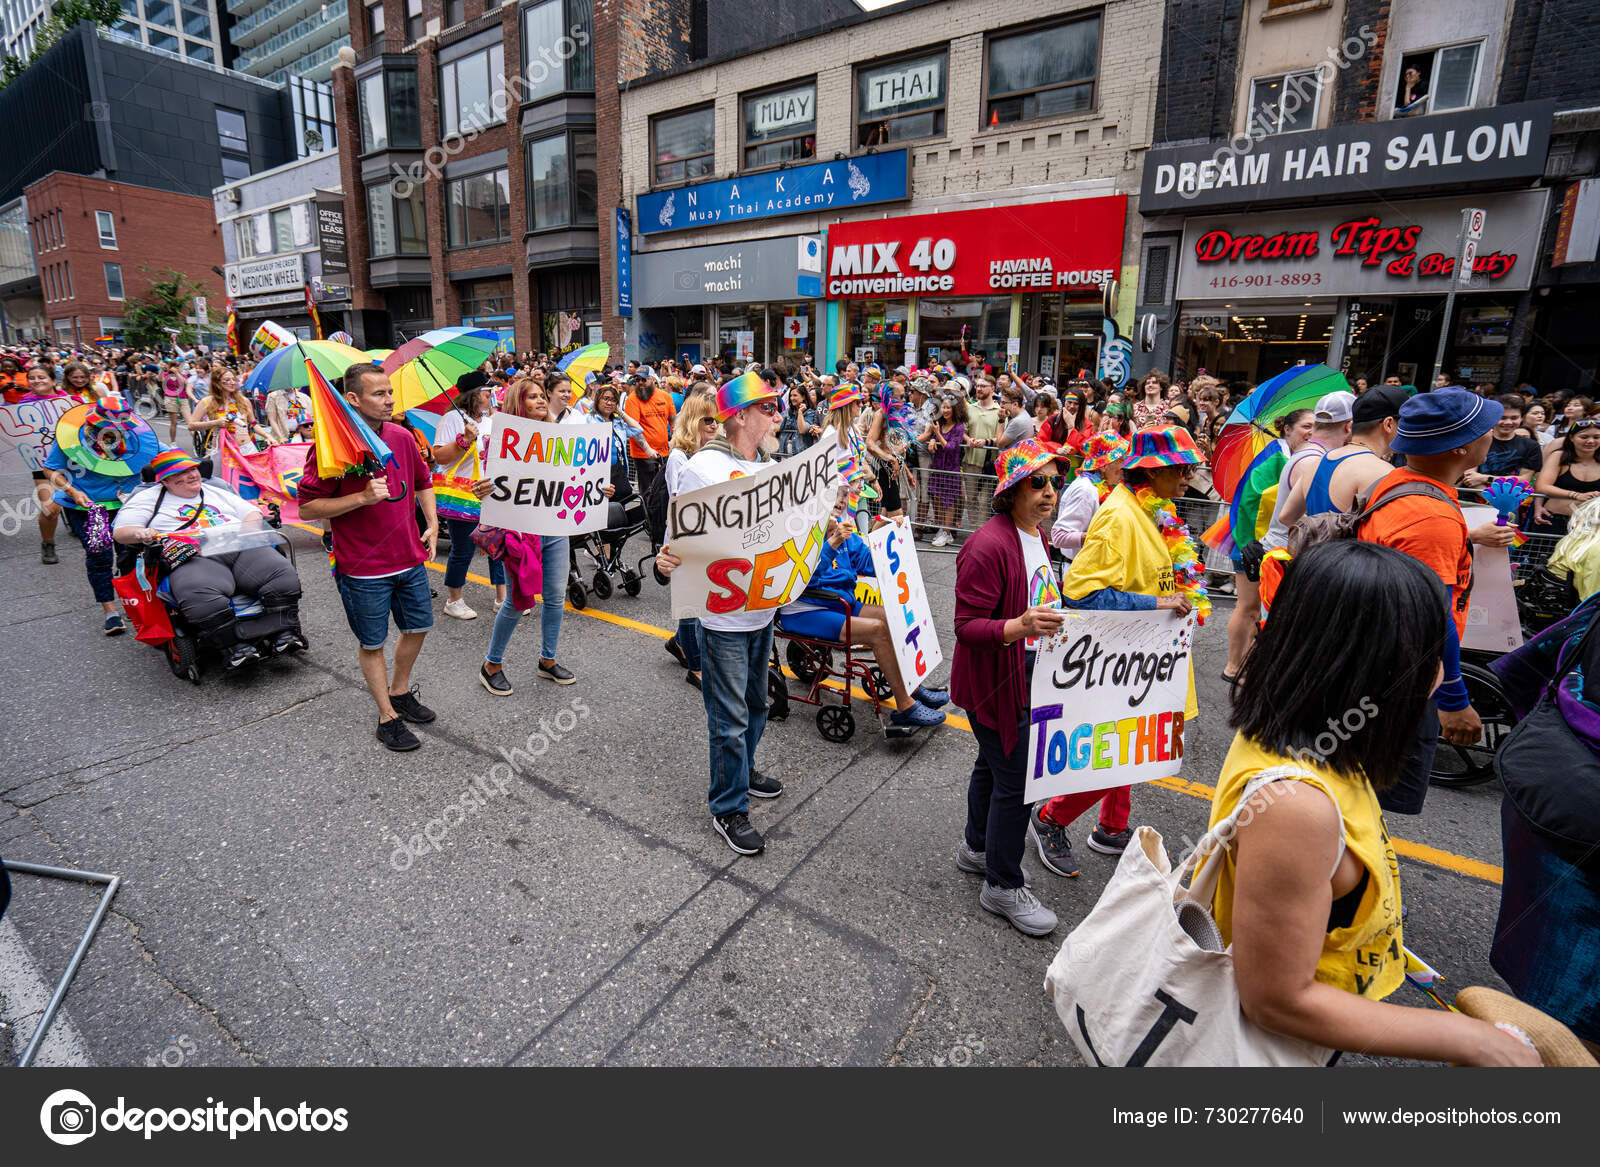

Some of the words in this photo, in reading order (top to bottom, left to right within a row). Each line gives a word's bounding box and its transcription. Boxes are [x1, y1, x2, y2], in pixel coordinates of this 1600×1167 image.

[875, 70, 932, 103] THAI
[761, 95, 810, 124] MUAY
[1154, 153, 1270, 195] DREAM
[1282, 141, 1371, 182] HAIR
[1384, 120, 1532, 172] SALON
[689, 209, 721, 221] Muay
[729, 201, 759, 216] Thai
[767, 192, 834, 210] Academy
[321, 224, 344, 234] LEASE
[1195, 229, 1320, 262] Dream
[1331, 217, 1423, 266] Tips
[704, 252, 742, 271] machi
[829, 241, 902, 276] MIX
[909, 238, 957, 273] 40
[989, 257, 1053, 274] HAVANA
[1420, 250, 1517, 278] Beuty
[242, 273, 273, 289] MEDICINE
[274, 269, 300, 285] WHEEL
[704, 274, 742, 292] machi
[829, 272, 955, 296] convenience
[989, 272, 1052, 289] COFFEE
[1056, 269, 1114, 285] HOUSE
[1209, 272, 1322, 289] 416-901-8893
[500, 428, 610, 467] RAINBOW
[742, 519, 775, 550] IS
[1052, 634, 1187, 707] Stronger
